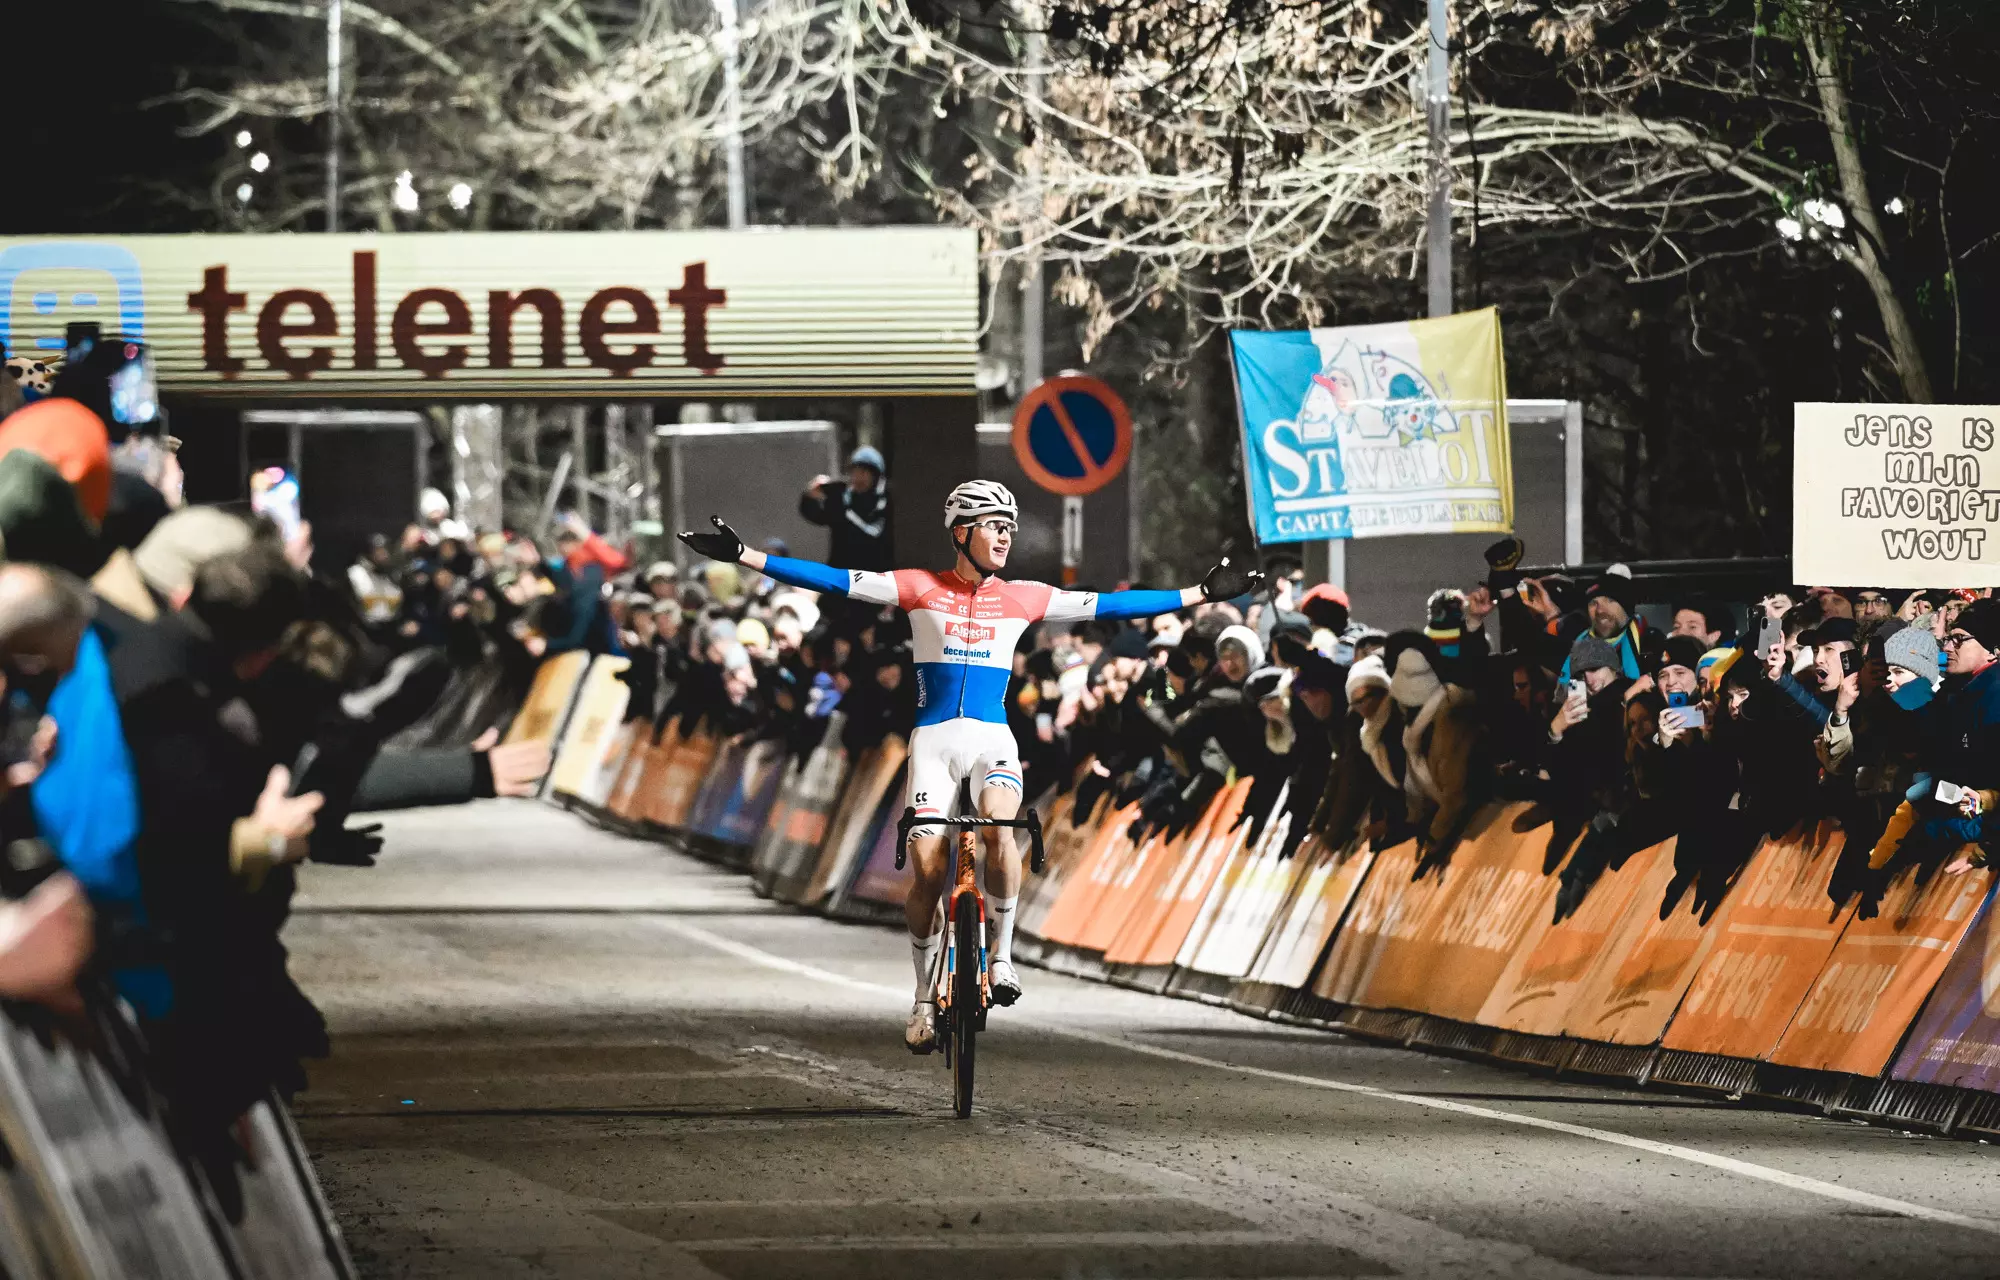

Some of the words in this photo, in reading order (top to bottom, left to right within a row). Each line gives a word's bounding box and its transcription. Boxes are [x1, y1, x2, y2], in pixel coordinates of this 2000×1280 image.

[188, 251, 727, 380] telenet
[1881, 528, 1986, 561] WOUT
[950, 623, 991, 639] Alpecin
[1686, 949, 1788, 1020] STOCK
[1798, 962, 1898, 1033] STOCK
